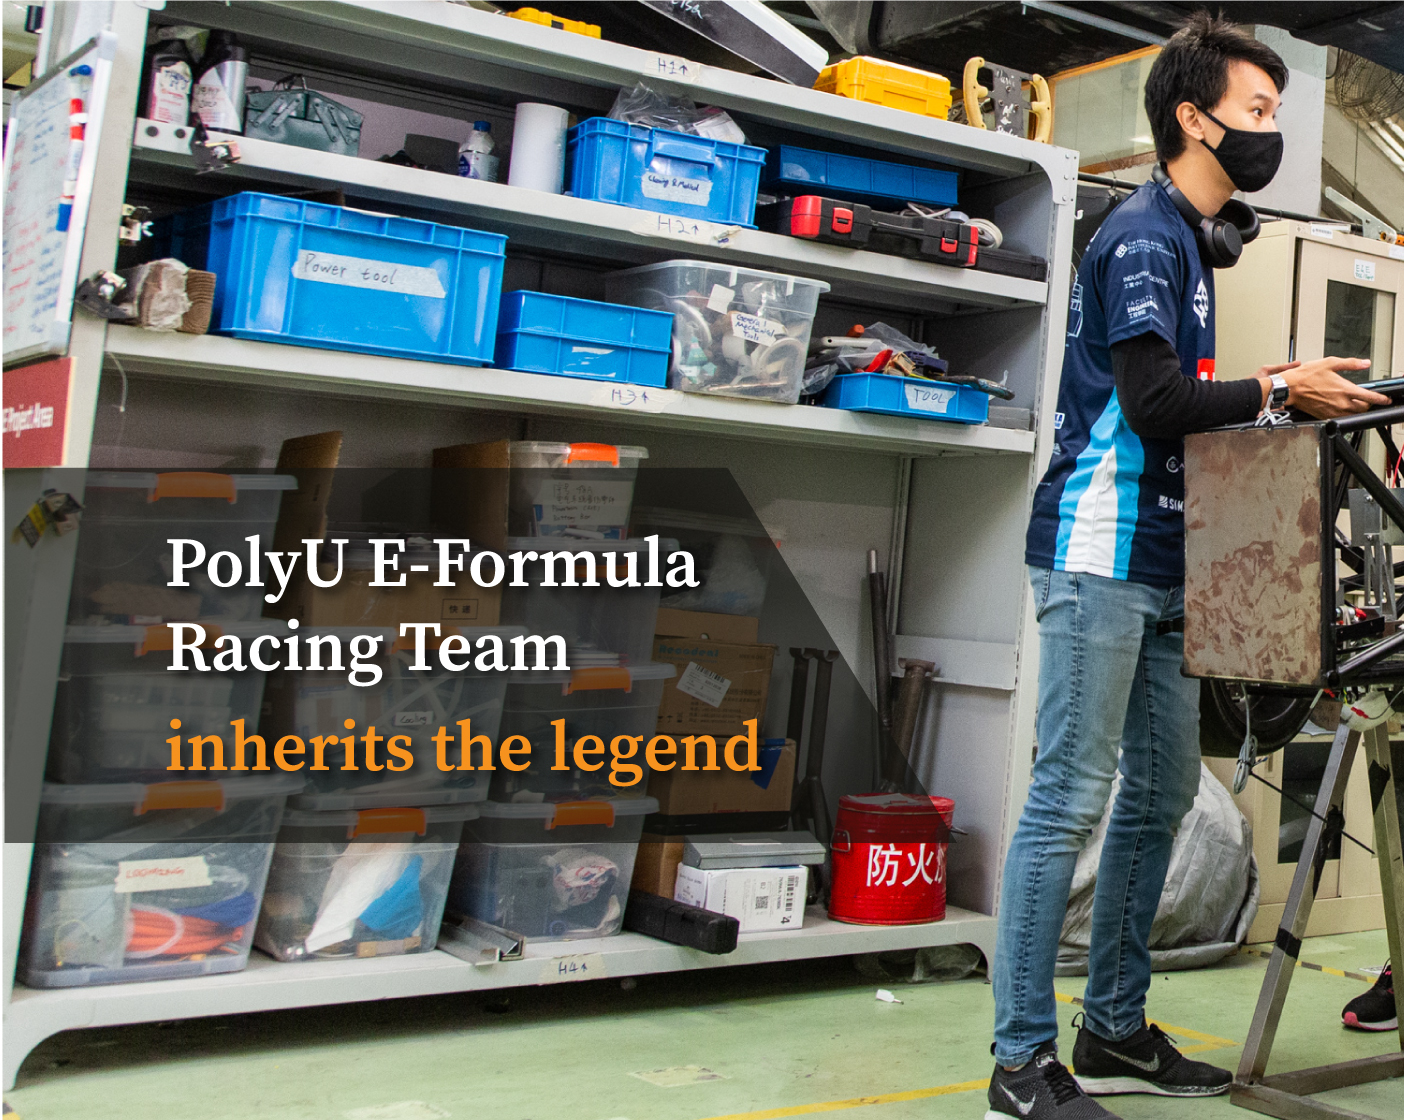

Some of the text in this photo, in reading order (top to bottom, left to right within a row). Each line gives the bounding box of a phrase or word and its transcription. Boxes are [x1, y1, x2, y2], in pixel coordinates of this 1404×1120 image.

[658, 57, 677, 75] H1
[657, 214, 690, 235] H2
[304, 253, 398, 285] Power tool
[1122, 270, 1149, 283] INDUSTRIA
[611, 388, 637, 406] H3
[913, 387, 946, 404] TOOL
[558, 961, 579, 976] H4
